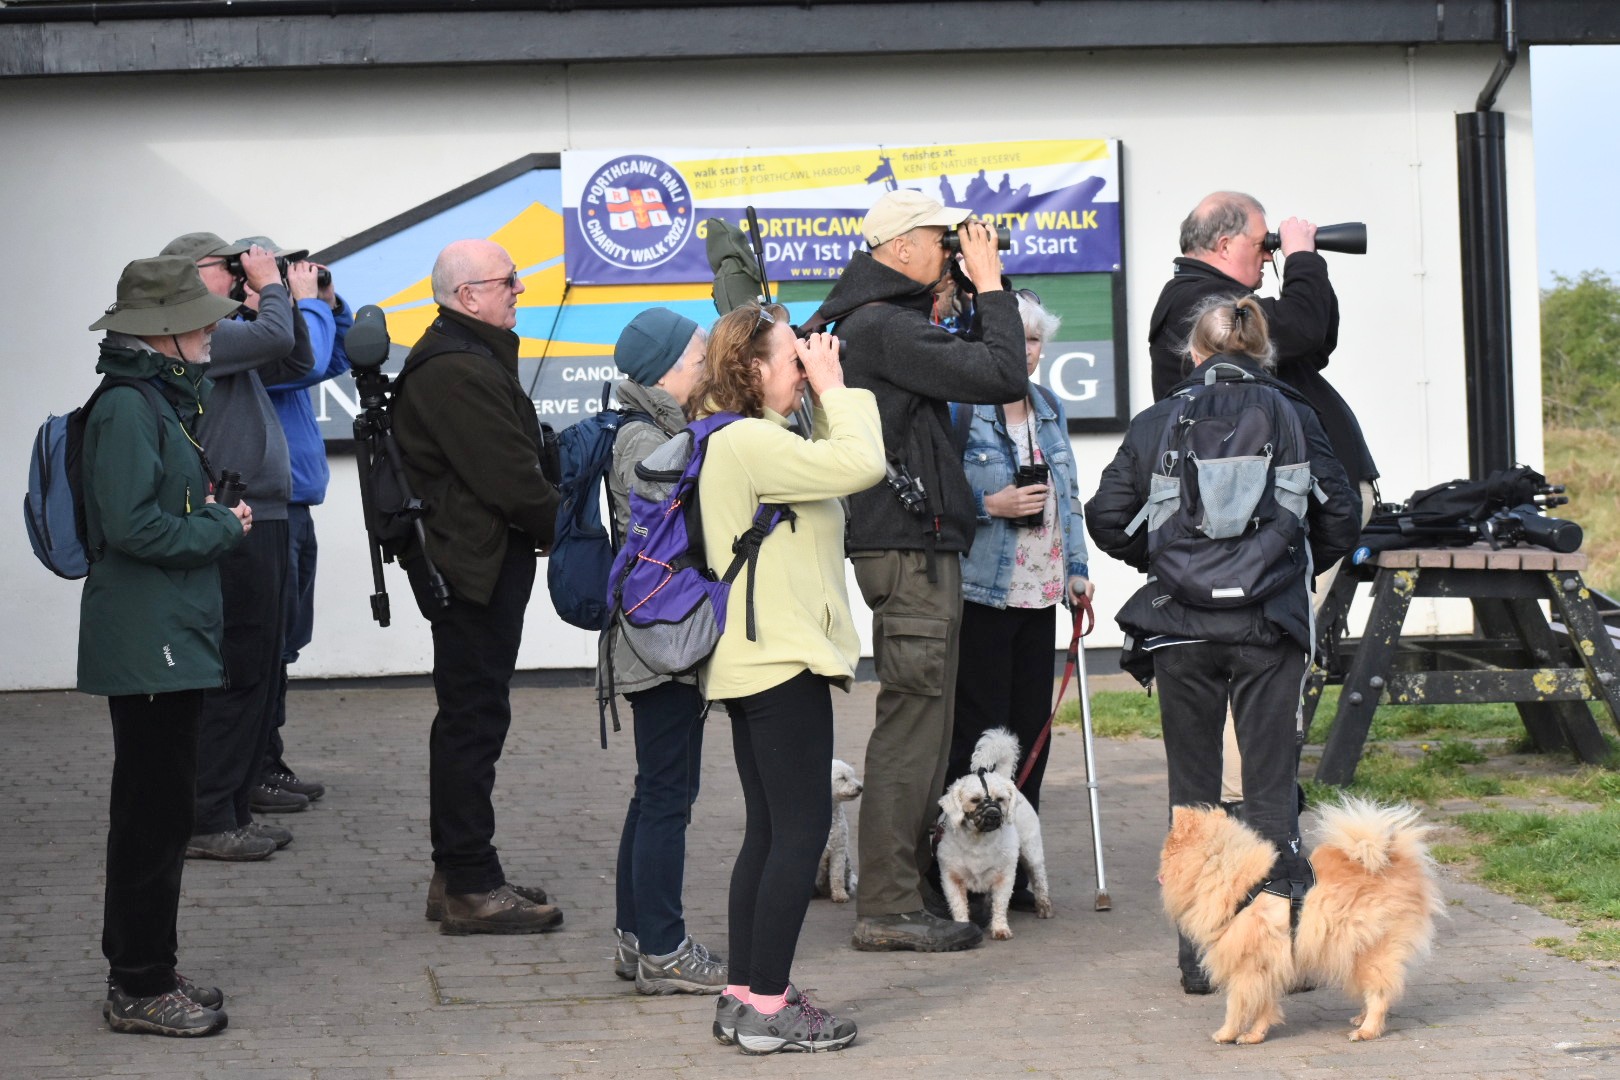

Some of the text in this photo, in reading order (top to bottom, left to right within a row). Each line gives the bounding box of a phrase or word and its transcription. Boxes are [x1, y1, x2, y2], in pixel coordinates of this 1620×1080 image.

[902, 149, 956, 162] finishes at:
[903, 153, 1021, 173] KENFIG NATURE RESERVE
[693, 163, 765, 178] walk starts at:
[695, 179, 717, 190] RNLI
[750, 170, 811, 184] PORTHCAWL
[813, 164, 862, 177] HARBOUR
[587, 160, 685, 205] PORTHCAWL RNLI
[612, 191, 622, 200] R
[619, 216, 628, 227] L
[739, 216, 864, 237] PORTHCAW
[1034, 210, 1098, 230] WALK
[587, 216, 687, 262] CHARITY WALK 2022
[813, 242, 841, 261] 1st
[1025, 235, 1078, 255] Start
[791, 267, 844, 278] www.po
[562, 366, 629, 382] CANOL
[533, 398, 579, 415] ERVE
